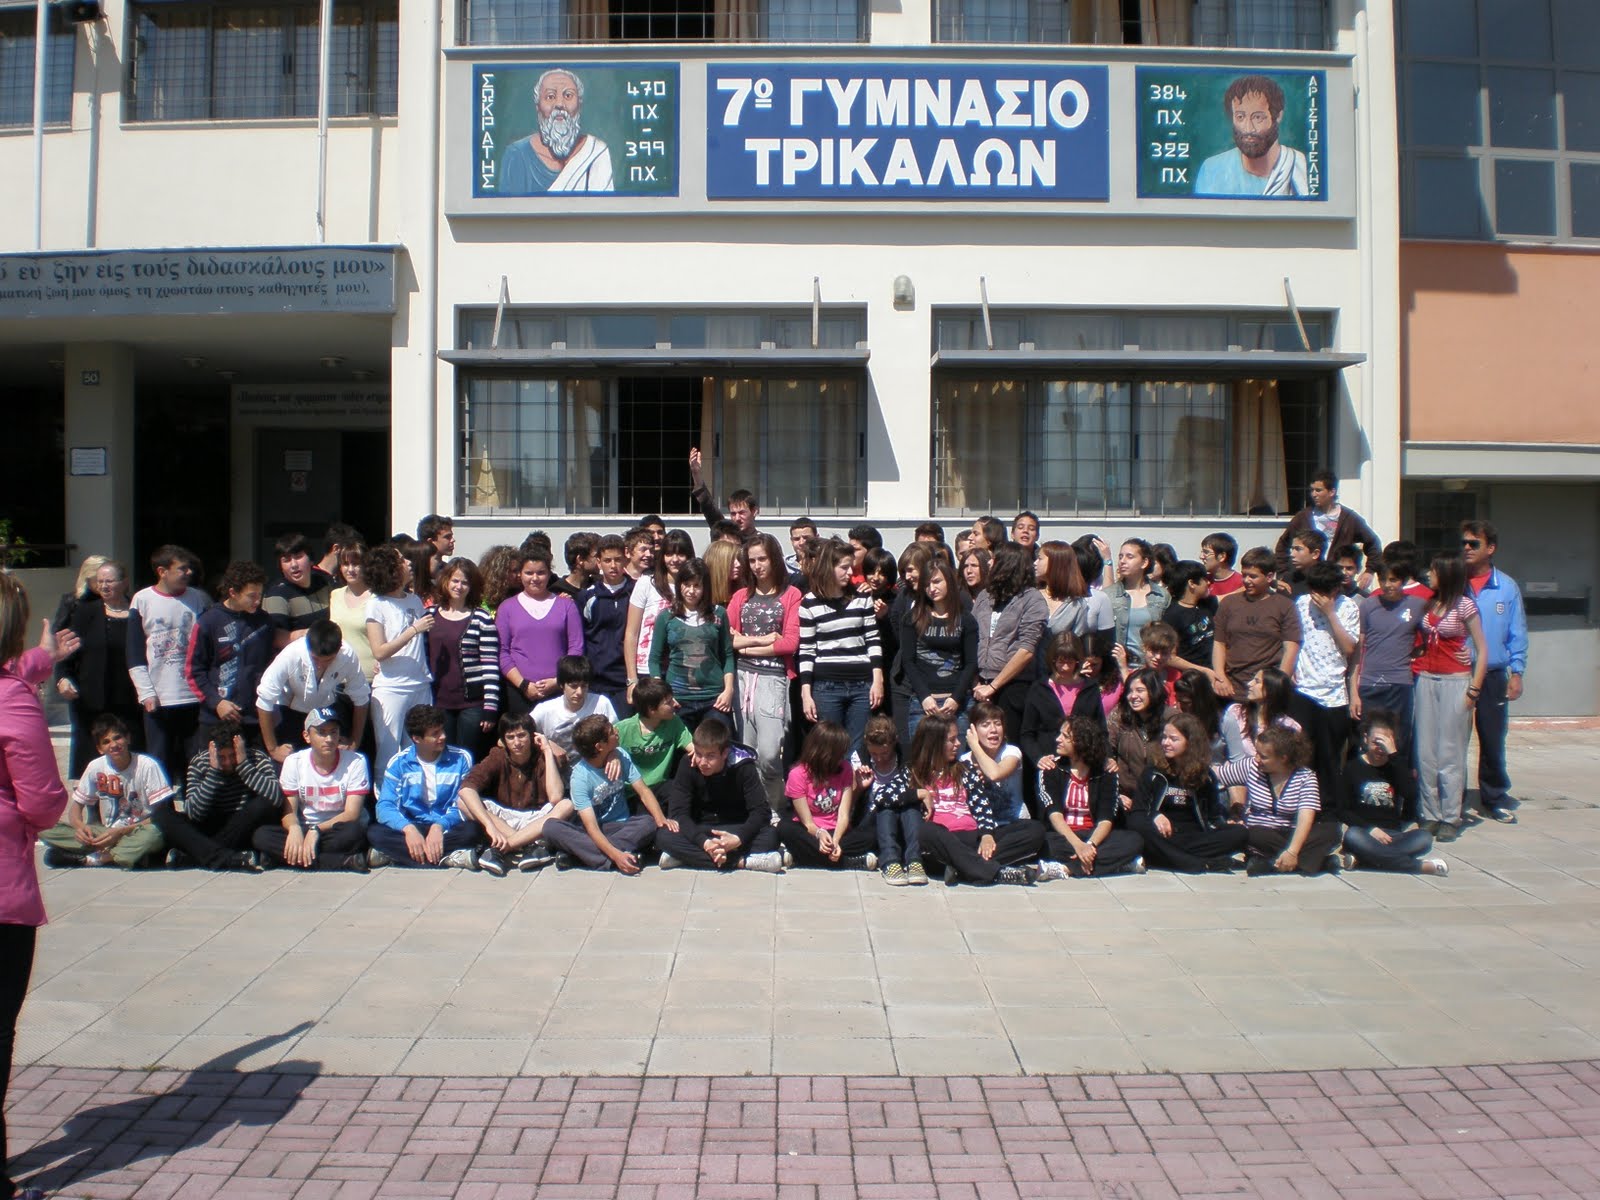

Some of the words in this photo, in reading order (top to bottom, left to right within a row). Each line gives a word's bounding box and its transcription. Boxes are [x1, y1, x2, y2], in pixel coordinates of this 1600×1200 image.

[627, 81, 666, 96] 470
[790, 78, 1090, 129] ΓΥΜΝΑΣΙΟ
[1150, 84, 1187, 100] 384
[481, 73, 495, 188] ΣΩΚΡΑΤΗΣ
[625, 141, 665, 156] 399
[1308, 75, 1320, 196] ΑΡΙΣΤΟΤΕΛΗΣ
[744, 137, 1056, 187] ΤΡΙΚΑΛΩΝ
